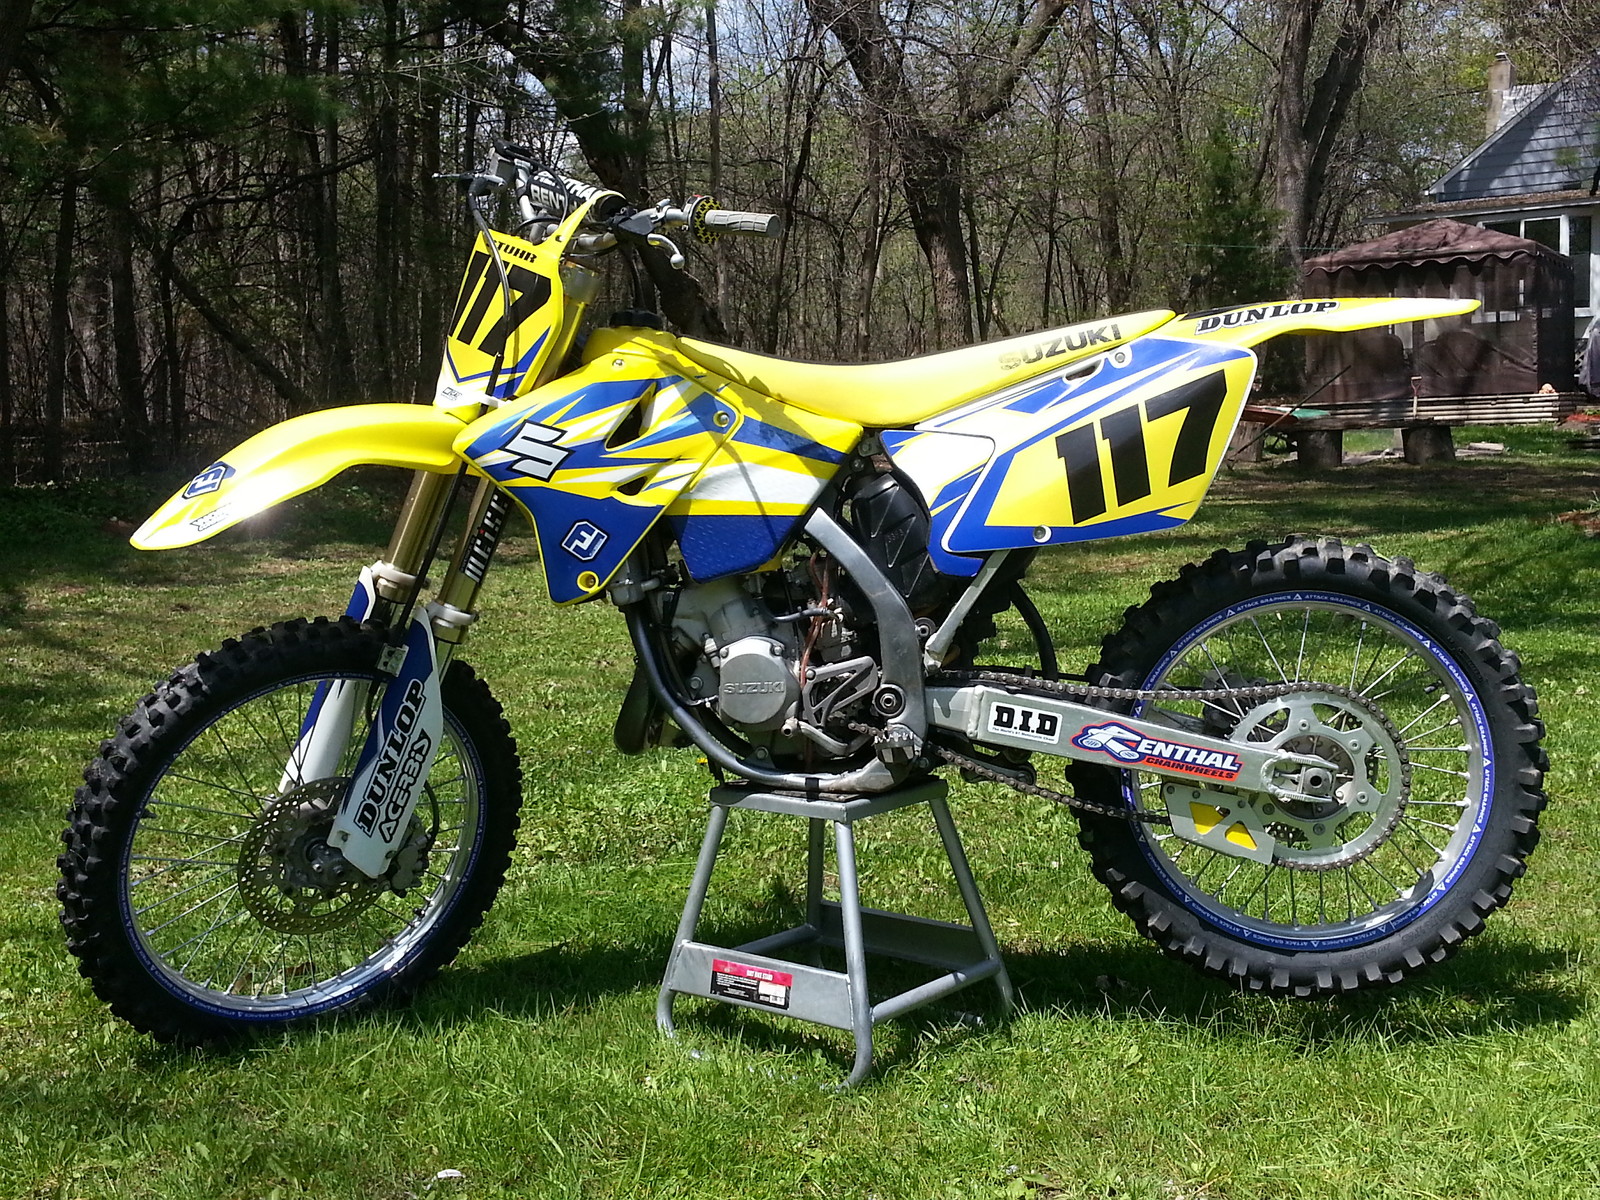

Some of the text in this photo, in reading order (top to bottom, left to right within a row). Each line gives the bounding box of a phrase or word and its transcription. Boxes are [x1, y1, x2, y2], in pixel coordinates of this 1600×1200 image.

[487, 240, 538, 264] TUHR
[448, 250, 552, 357] 117
[1197, 301, 1338, 332] DUNLOP
[998, 323, 1122, 370] SUZUKI
[1055, 369, 1228, 525] 117
[723, 681, 785, 695] SUZUKI
[993, 705, 1058, 737] D.I.D
[355, 679, 426, 837] DUNLOP
[1079, 725, 1239, 771] RENTHAL
[1145, 757, 1235, 779] CHAINWHEELS
